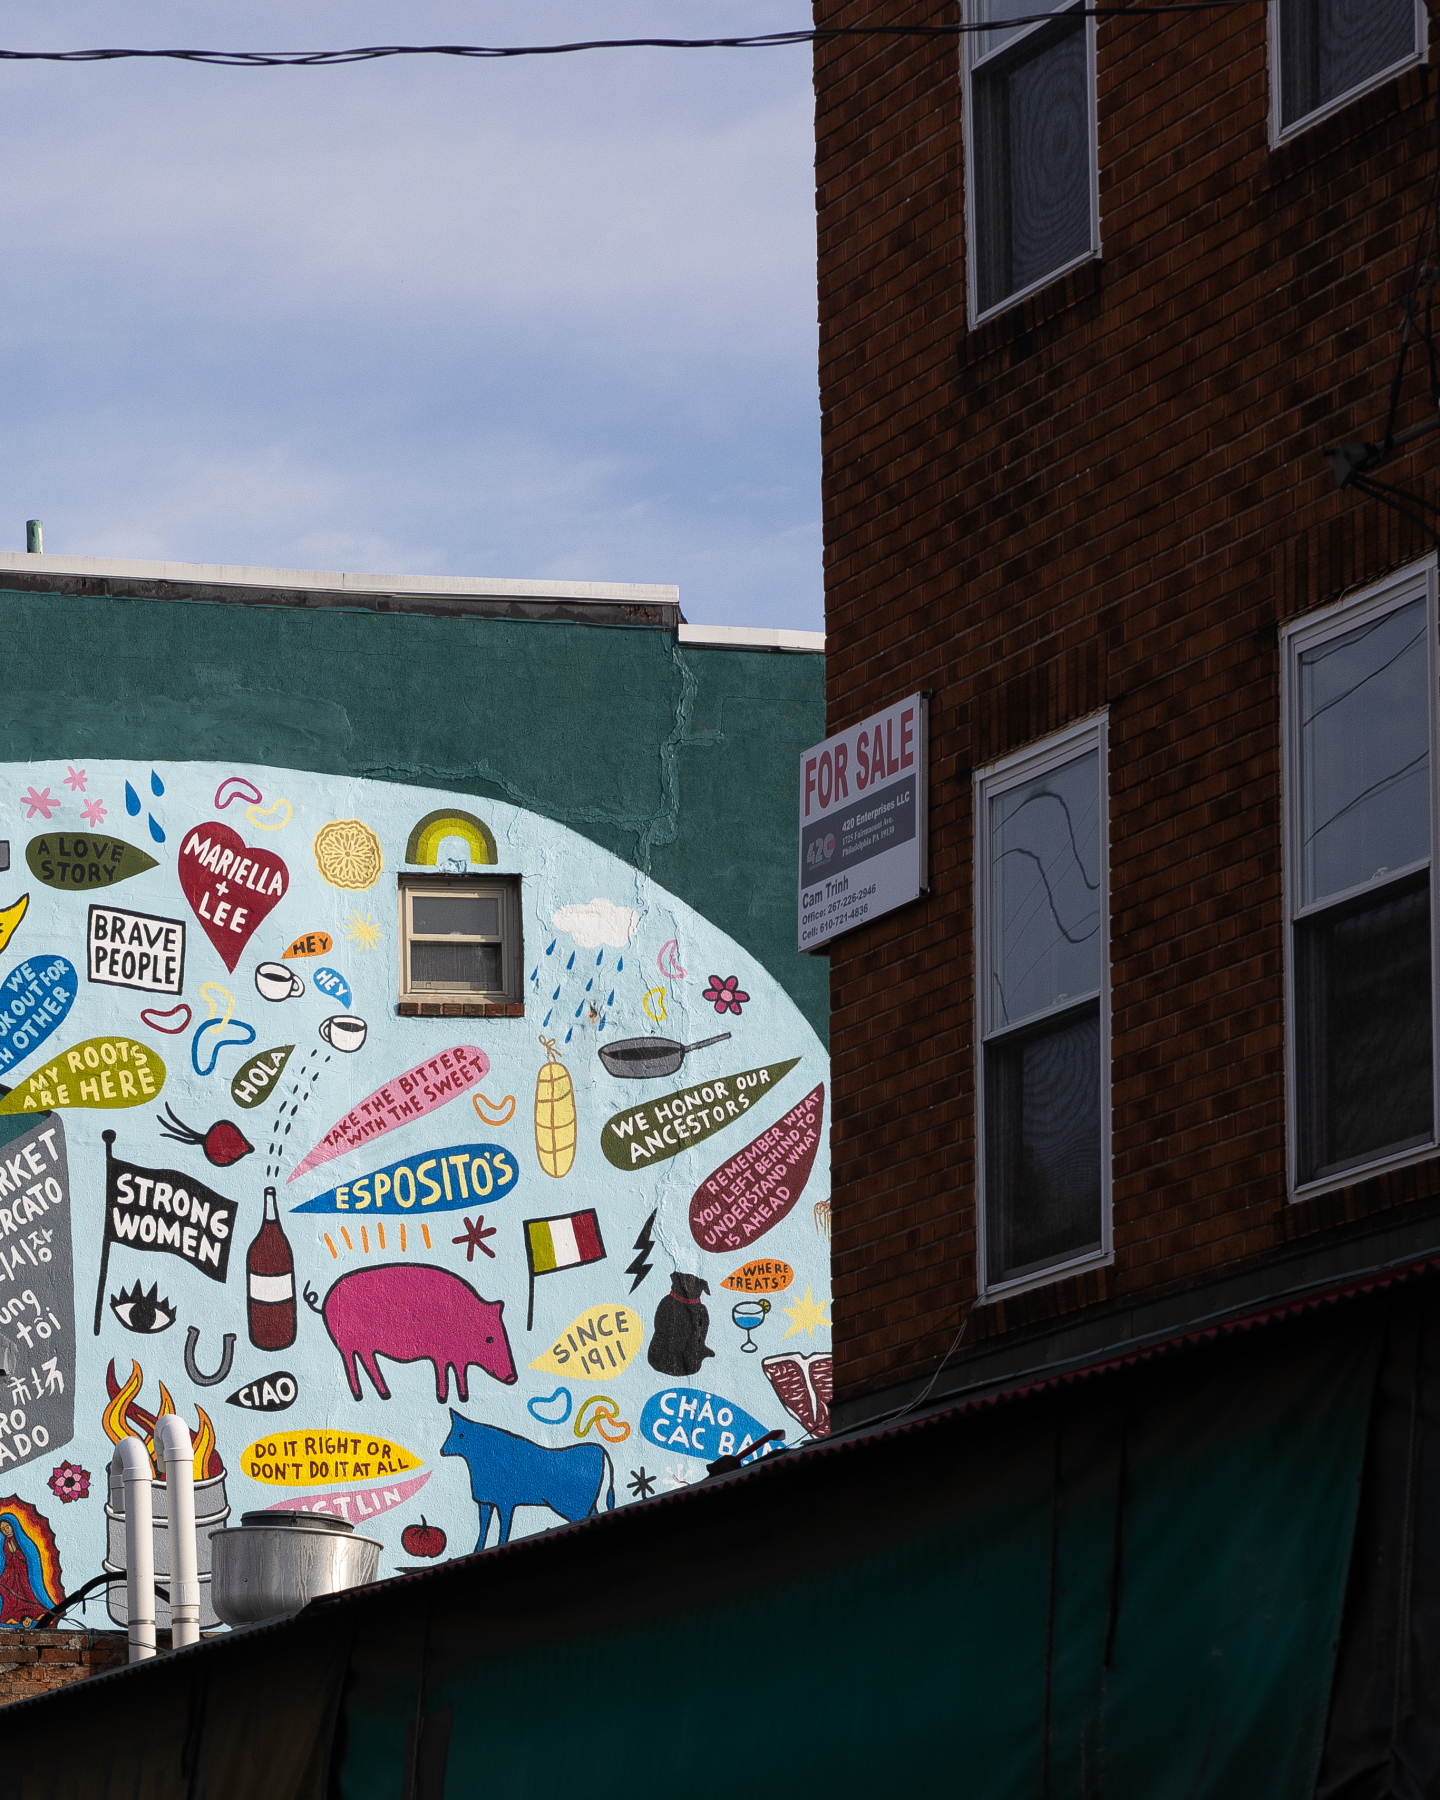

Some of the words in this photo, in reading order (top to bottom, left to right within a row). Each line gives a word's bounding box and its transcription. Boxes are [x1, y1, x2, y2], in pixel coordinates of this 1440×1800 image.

[805, 742, 848, 817] FOR
[856, 707, 914, 791] SALE
[842, 818, 854, 831] 420
[856, 801, 895, 826] Enterprises
[897, 791, 910, 806] LLC
[38, 839, 50, 856] A
[59, 837, 124, 865] LOVE
[873, 832, 879, 843] PA
[42, 860, 117, 883] STORY
[184, 832, 283, 896] MARIELLA
[199, 891, 248, 933] LEE
[802, 891, 823, 909] Cam
[826, 876, 848, 900] Trinh
[802, 907, 826, 925] Office:
[828, 883, 877, 914] 267-226-2946
[94, 915, 176, 952] BRAVE
[802, 926, 818, 941] Cell:
[819, 903, 868, 932] 610-721-4836
[292, 937, 329, 955] HEY
[6, 962, 36, 993] WE
[11, 981, 44, 1015] OUT
[39, 959, 70, 991] FOR
[94, 951, 177, 986] PEOPLE
[316, 969, 348, 997] HEY
[13, 989, 71, 1051] OTHER
[29, 1065, 59, 1093] MY
[68, 1041, 148, 1073] ROOTS
[234, 1051, 286, 1103] HOLA
[23, 1083, 70, 1109] ARE
[80, 1068, 156, 1102] HERE
[323, 1112, 360, 1147] TAKE
[361, 1088, 394, 1116] THE
[399, 1047, 467, 1091] BITTER
[347, 1116, 387, 1146] WITH
[387, 1097, 423, 1122] THE
[426, 1056, 484, 1103] SWEET
[610, 1111, 650, 1138] WE
[654, 1082, 729, 1123] HONOR
[737, 1069, 771, 1090] OUR
[630, 1095, 750, 1164] ANCESTORS
[706, 1127, 784, 1195] REMEMBER
[784, 1092, 819, 1126] WHAT
[335, 1153, 513, 1209] ESPOSITO'S
[693, 1202, 721, 1226] YOU
[722, 1169, 756, 1203] LEFT
[754, 1129, 800, 1175] BEHIND
[797, 1113, 815, 1129] TO
[705, 1164, 788, 1245] UNDERSTAND
[786, 1129, 817, 1164] WHAT
[116, 1173, 229, 1239] STRONG
[725, 1233, 740, 1246] IS
[742, 1186, 790, 1236] AHEAD
[112, 1207, 222, 1267] WOMEN
[728, 1275, 787, 1290] TREATS?
[743, 1263, 789, 1276] WHERE
[16, 1306, 61, 1350] tôi
[552, 1310, 629, 1365] SINCE
[580, 1340, 626, 1375] 1911
[238, 1376, 295, 1406] CIAO
[251, 1462, 302, 1479] DON'T
[310, 1461, 329, 1478] DO
[334, 1461, 347, 1477] IT
[353, 1463, 369, 1476] AT
[377, 1457, 409, 1474] ALL
[255, 1444, 277, 1458] DO
[284, 1441, 298, 1457] IT
[304, 1437, 361, 1455] RIGHT
[367, 1442, 391, 1459] OR
